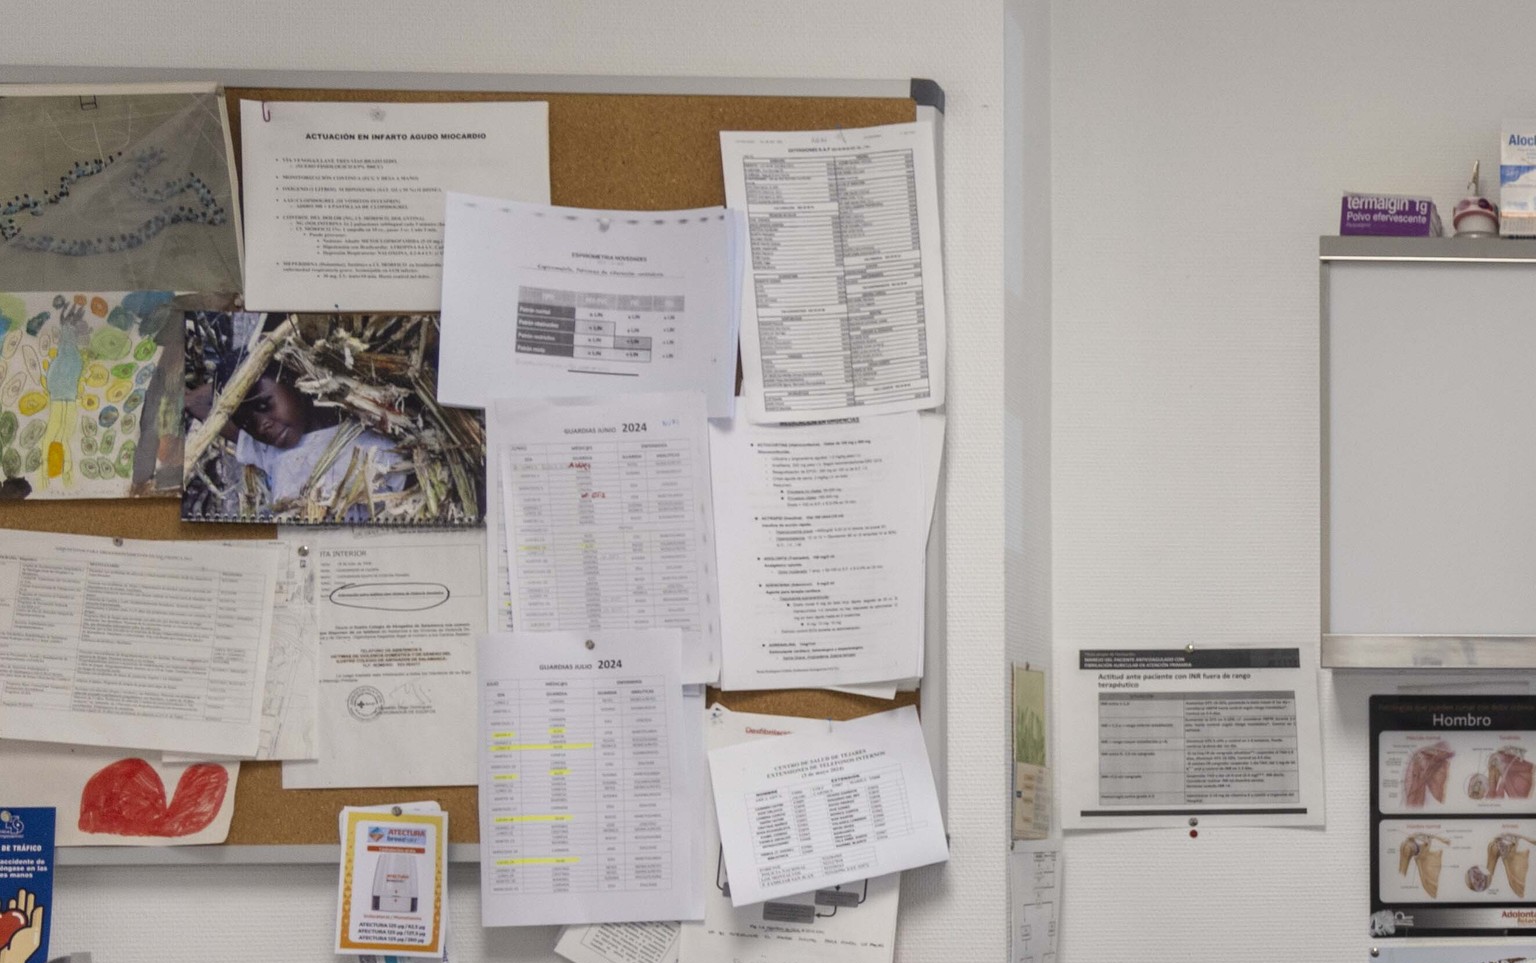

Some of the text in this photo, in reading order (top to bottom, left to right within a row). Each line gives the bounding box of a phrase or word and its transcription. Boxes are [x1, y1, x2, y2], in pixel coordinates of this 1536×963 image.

[305, 131, 487, 141] ACTUACIÓN EN INFARTO AGUDO MIOCARDIO
[1346, 197, 1428, 215] termalgin 1g
[1346, 211, 1427, 224] Polvo efervescente
[597, 426, 616, 434] JUNIO
[621, 422, 648, 433] 2024
[539, 663, 573, 671] GUARDIAS
[597, 659, 623, 670] 2024
[1098, 672, 1124, 680] Actitud
[1143, 673, 1173, 682] paciente
[1202, 672, 1220, 680] fuera
[1221, 672, 1233, 680] de
[1234, 673, 1251, 681] rango
[1098, 680, 1139, 689] terapéutico
[1432, 713, 1491, 727] Hombro
[766, 767, 809, 779] EXTENSIONES
[855, 751, 886, 762] INTERNOS
[774, 762, 799, 772] CENTRO
[809, 757, 830, 765] SALUD
[840, 748, 867, 758] TEJARES
[388, 827, 426, 837] ATECTURA
[1, 843, 42, 852] DE TRÁFICO
